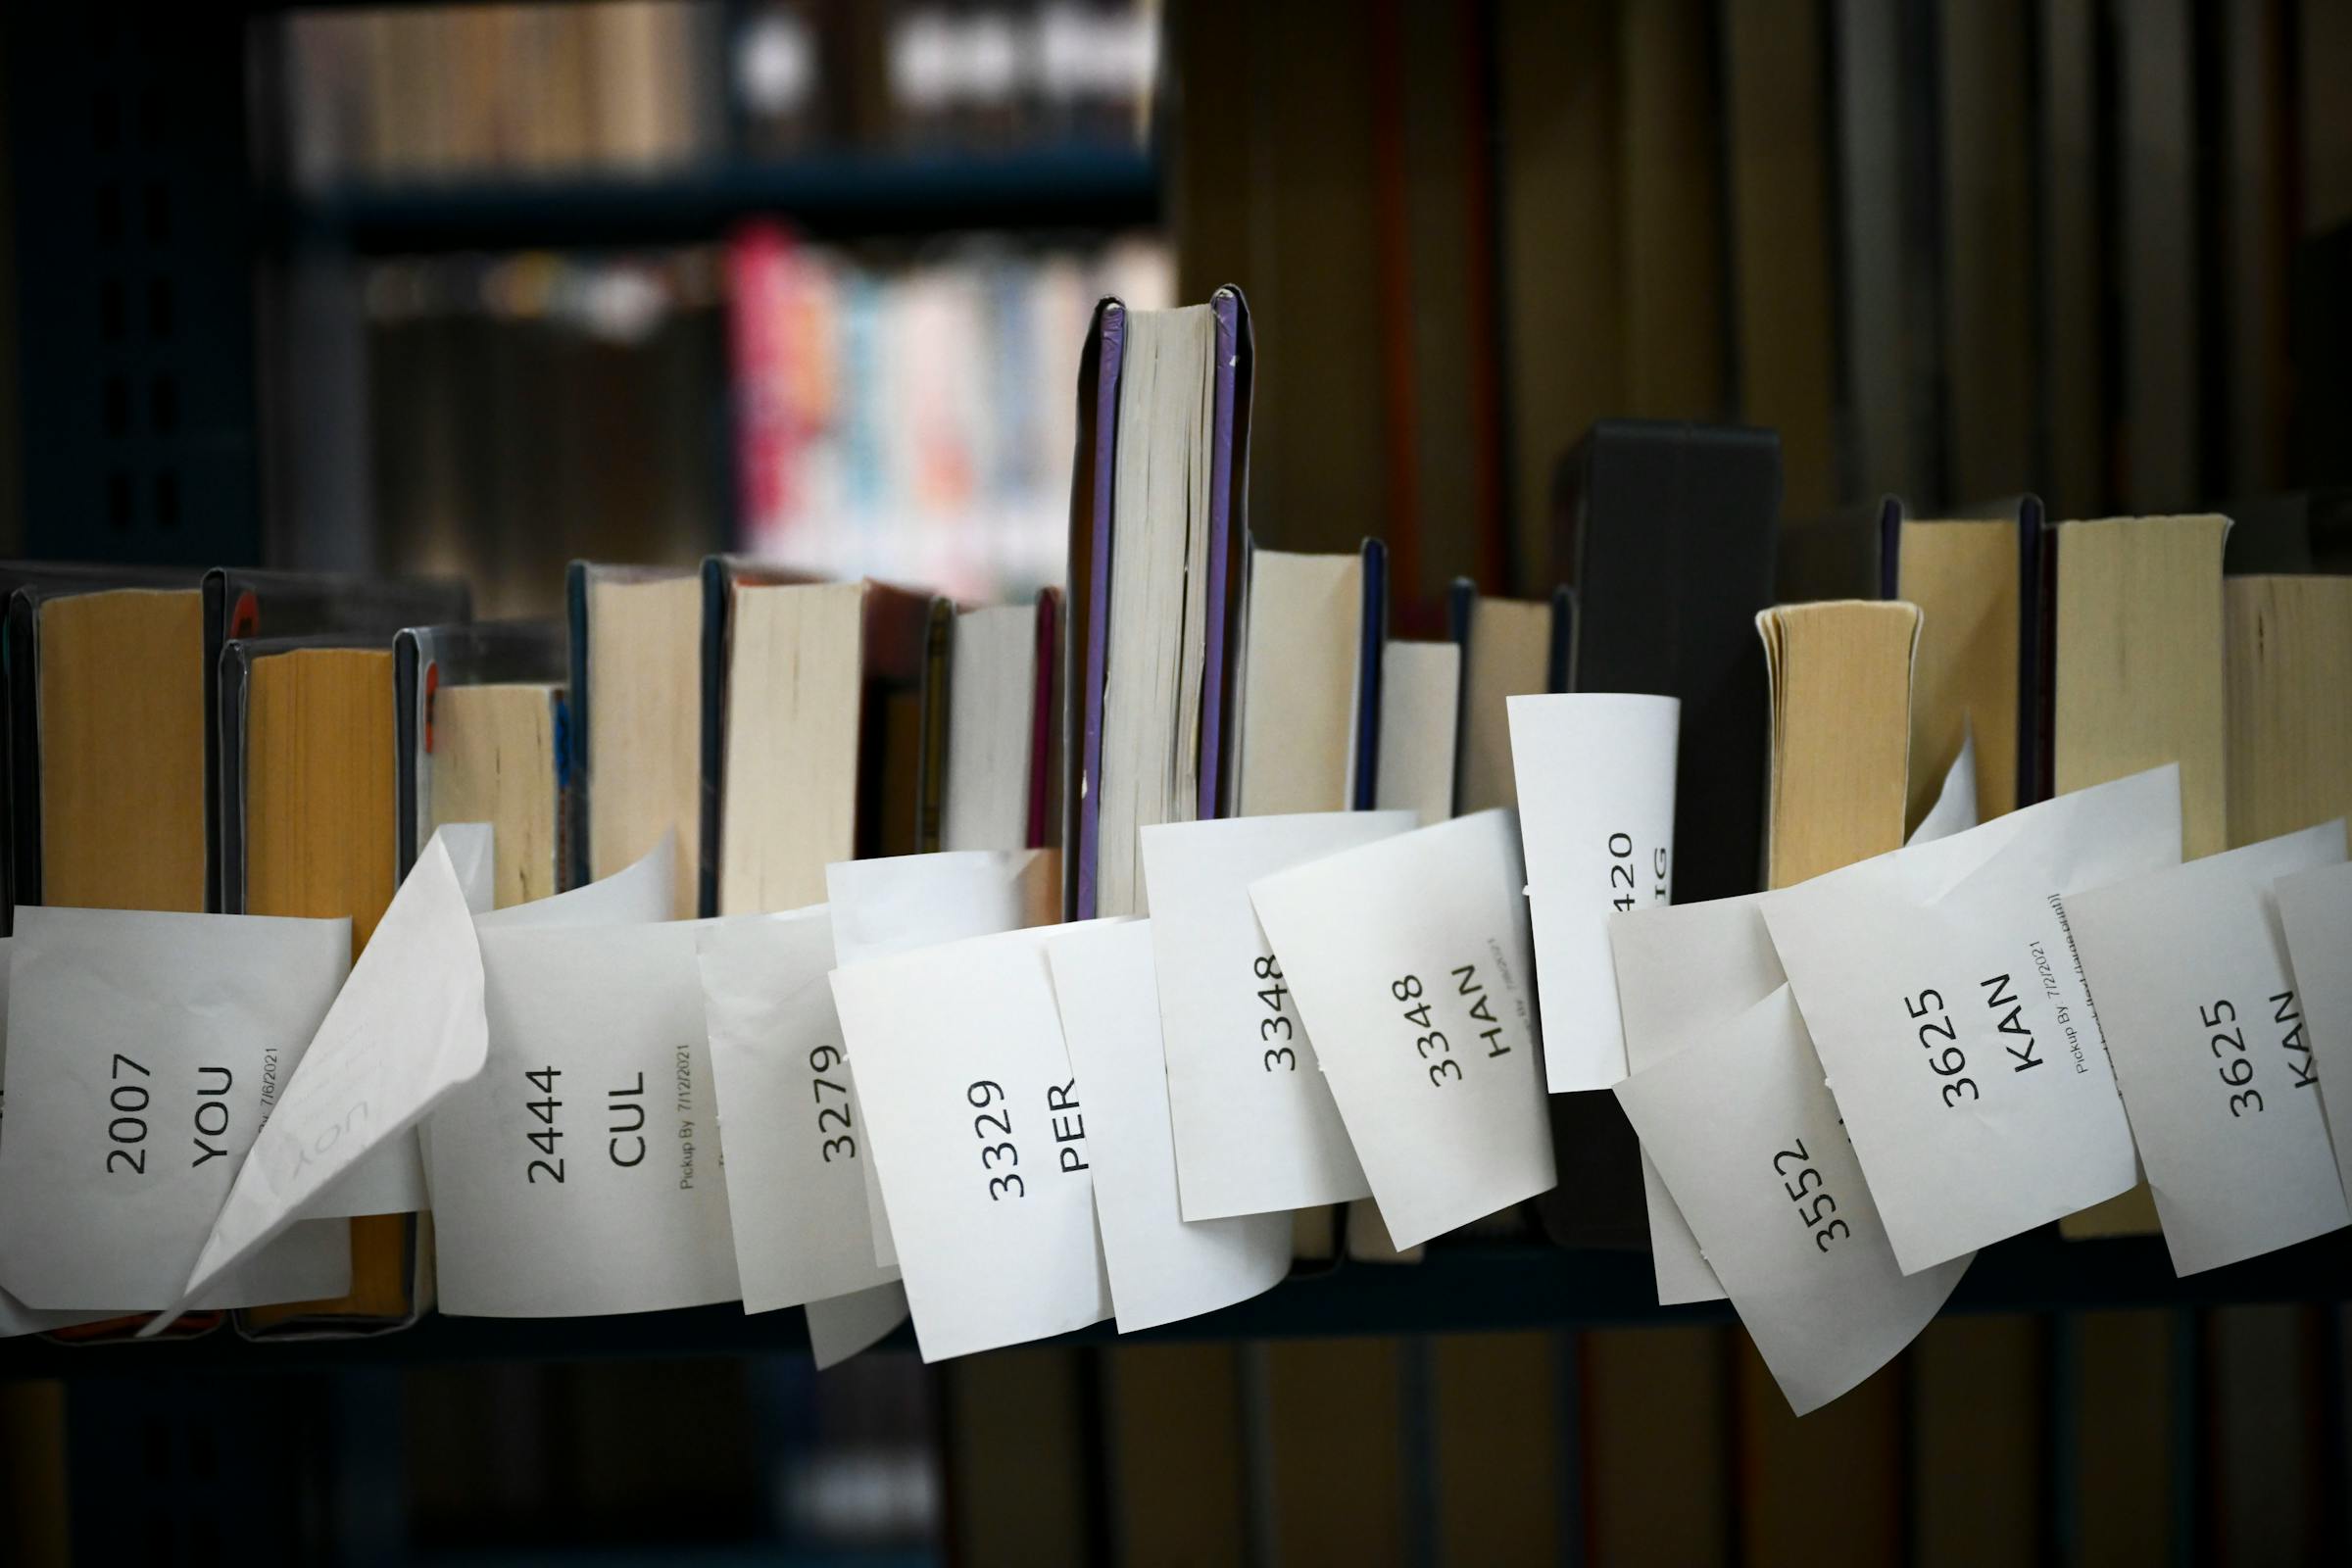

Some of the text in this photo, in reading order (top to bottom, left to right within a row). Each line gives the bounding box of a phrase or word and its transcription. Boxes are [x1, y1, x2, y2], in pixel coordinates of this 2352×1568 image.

[1608, 832, 1636, 912] 420
[1652, 847, 1668, 901] IG
[1253, 955, 1296, 1072] 3348
[1451, 965, 1511, 1058] HAN
[2029, 940, 2060, 1000] 7/2/2021
[1392, 975, 1462, 1087] 3348
[1904, 989, 1980, 1107] 3625
[1980, 973, 2043, 1073] KAN
[2065, 1025, 2089, 1075] Pickup
[2199, 1000, 2264, 1117] 3625
[2269, 990, 2319, 1089] KAN
[106, 1054, 151, 1175] 2007
[192, 1067, 232, 1168] YOU
[260, 1048, 278, 1106] 7/6/2021
[524, 1065, 564, 1184] 2444
[609, 1072, 646, 1167] CUL
[676, 1044, 692, 1112] 7/12/2021
[809, 1045, 856, 1162] 3279
[1047, 1078, 1090, 1173] PER
[679, 1143, 697, 1190] Pickup
[967, 1080, 1024, 1200] 3329
[1773, 1138, 1850, 1253] 3552
